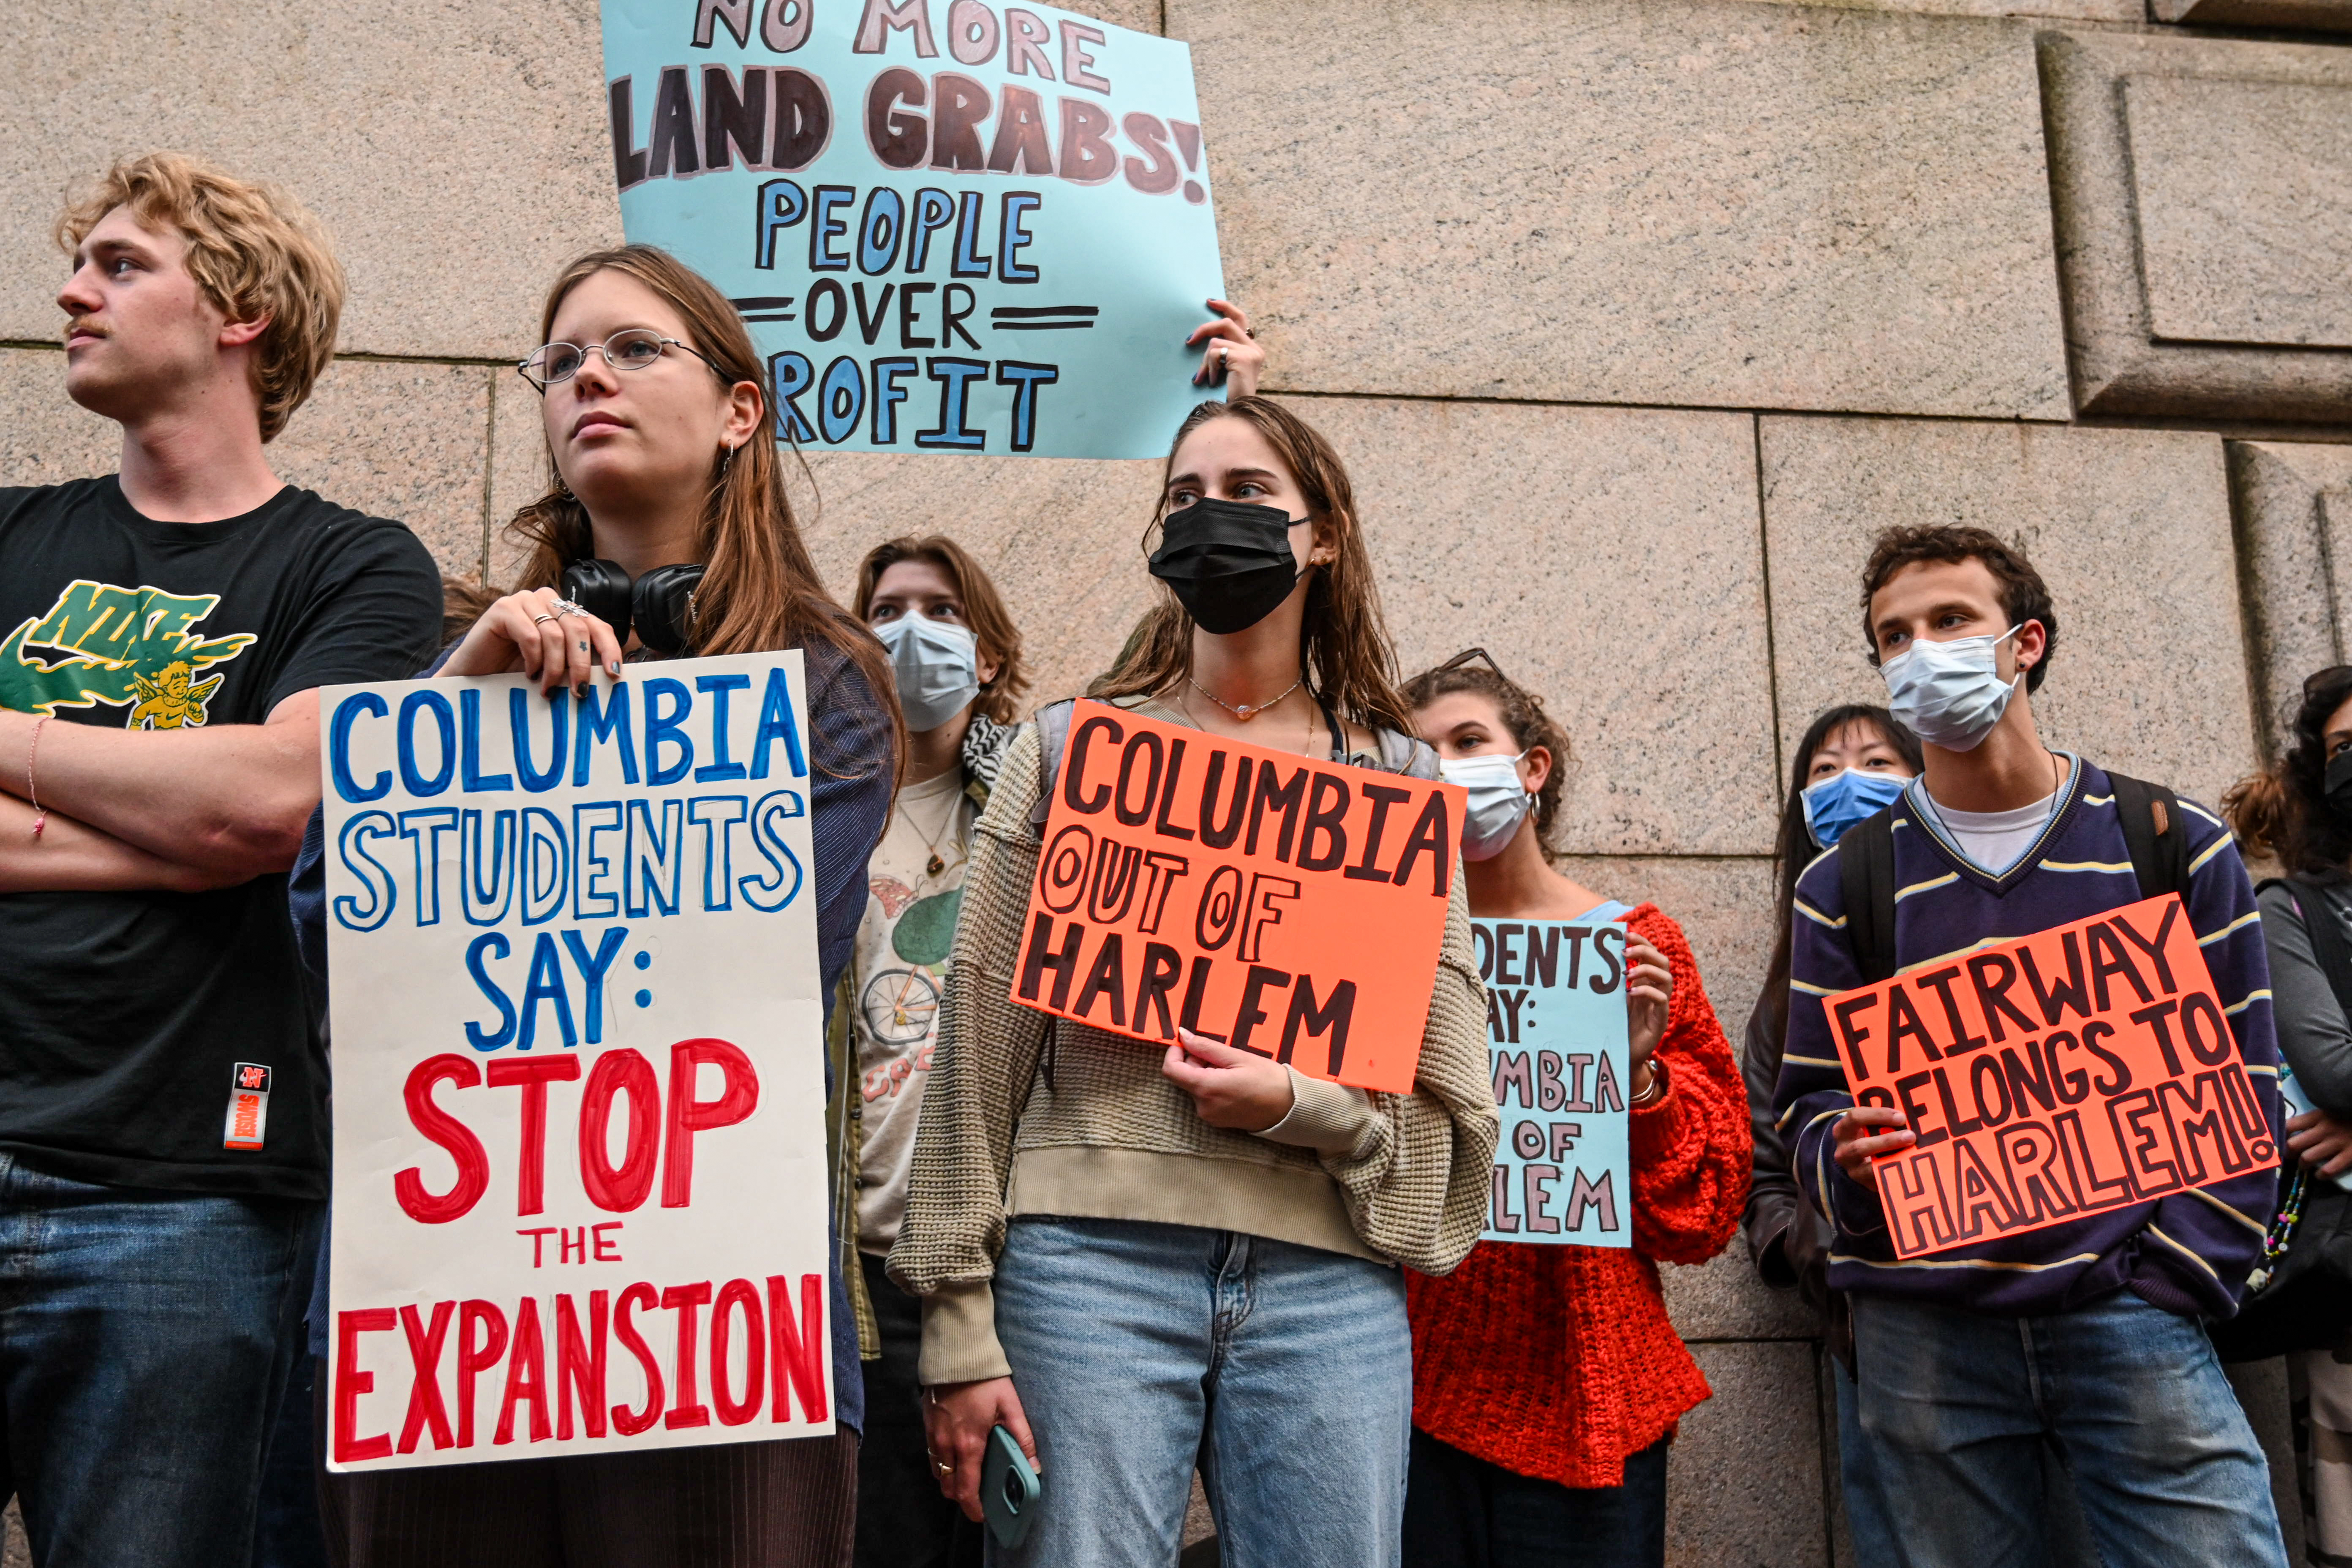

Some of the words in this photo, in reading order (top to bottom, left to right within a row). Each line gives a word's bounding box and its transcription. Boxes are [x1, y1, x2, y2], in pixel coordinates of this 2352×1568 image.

[691, 0, 812, 53] NO
[853, 0, 1110, 96] MORE
[609, 64, 834, 193] LAND
[863, 65, 1207, 207] GRABS!
[754, 178, 1042, 284] PEOPLE
[805, 278, 982, 351] OVER
[767, 351, 1059, 452] ROFIT
[329, 667, 808, 803] COLUMBIA
[333, 790, 805, 932] STUDENTS
[1064, 716, 1448, 897] COLUMBIA
[1040, 824, 1189, 935] OUT
[1195, 865, 1301, 962] OF
[464, 927, 652, 1051] SAY:
[1018, 911, 1357, 1077] HARLEM
[1470, 923, 1626, 994] DENTS
[1487, 988, 1535, 1043] AY:
[1834, 900, 2182, 1081] FAIRWAY
[1490, 1049, 1625, 1113] MBIA
[2129, 991, 2232, 1078] TO
[395, 1038, 760, 1224] STOP
[1512, 1120, 1582, 1163] OF
[1878, 1062, 2274, 1255] HARLEM!
[516, 1221, 623, 1268] THE
[1484, 1164, 1620, 1234] LEM
[334, 1273, 828, 1463] EXPANSION
